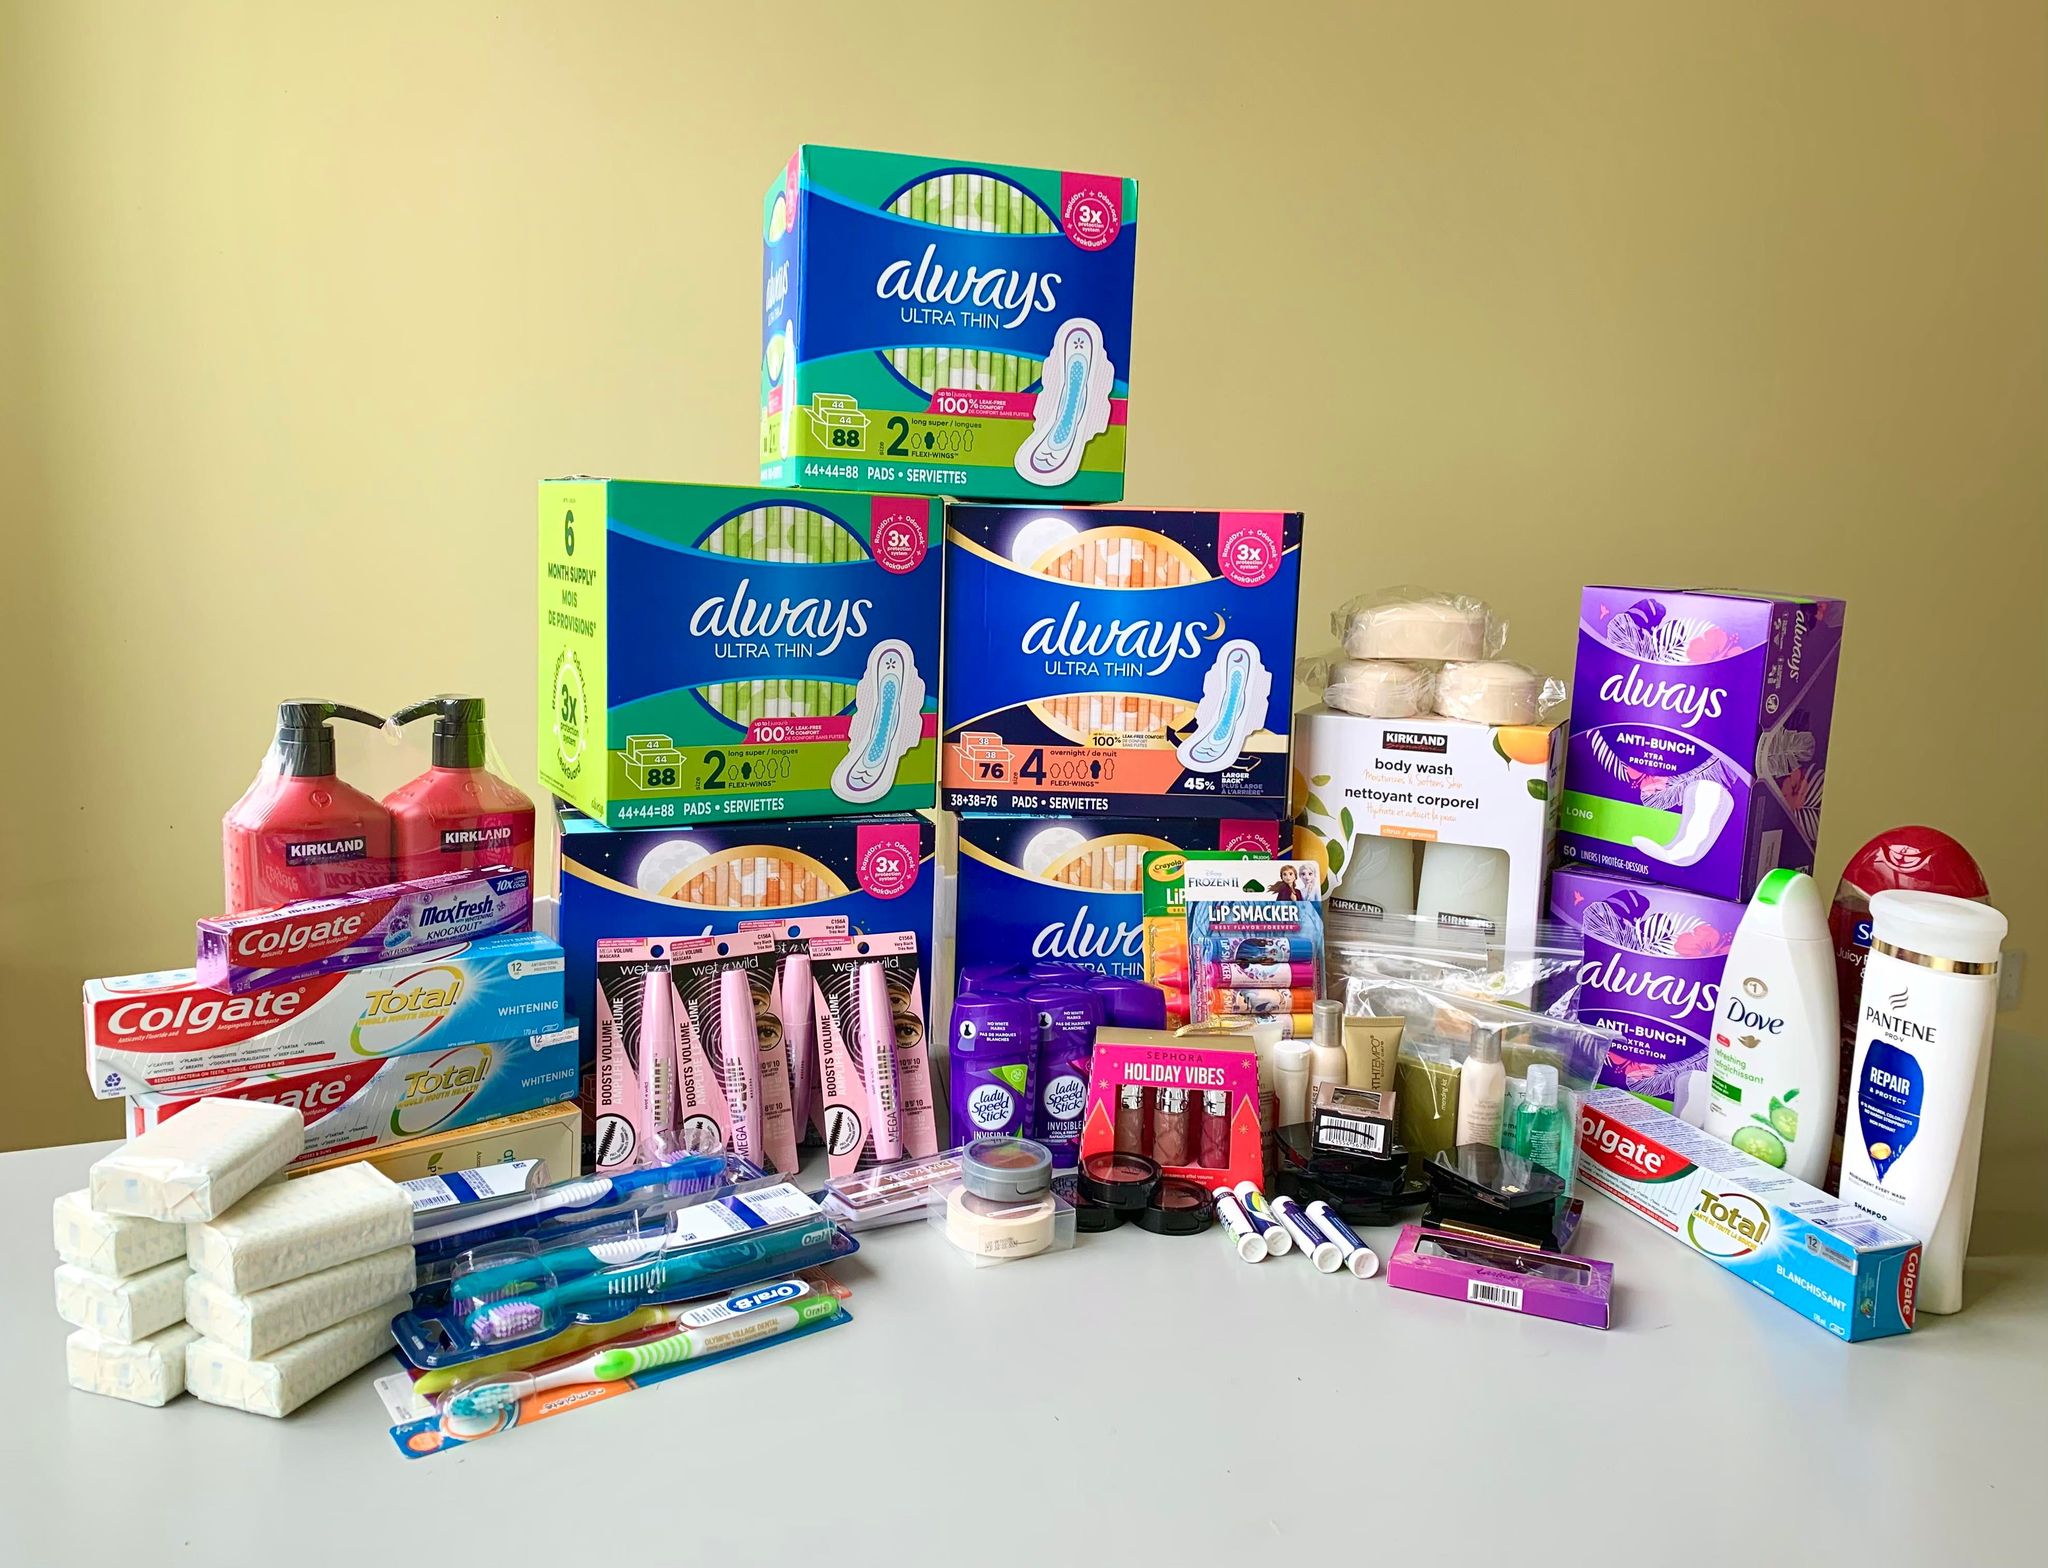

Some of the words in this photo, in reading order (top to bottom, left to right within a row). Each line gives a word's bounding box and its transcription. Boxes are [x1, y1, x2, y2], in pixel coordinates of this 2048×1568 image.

[1079, 205, 1102, 223] 3x
[876, 243, 1062, 329] always
[901, 307, 955, 326] ULTRA
[961, 311, 999, 329] THIN
[832, 401, 844, 409] 44
[911, 418, 927, 426] long
[928, 420, 949, 428] super
[954, 421, 982, 429] longues
[833, 429, 860, 447] 88
[887, 416, 909, 456] 2
[804, 463, 859, 479] 44+44=88
[867, 467, 894, 481] PADS
[907, 469, 967, 484] SERVIETTES
[565, 509, 574, 557] 6
[875, 516, 893, 544] RapidDry
[906, 516, 925, 544] OdorLock
[888, 530, 910, 547] 3x
[1222, 531, 1243, 558] RapidDry
[1257, 530, 1278, 558] OdorLock
[1237, 544, 1261, 560] 3x
[548, 562, 570, 581] MONTH
[882, 558, 915, 570] LeakGuard
[562, 589, 578, 608] MOIS
[548, 609, 556, 627] DE
[690, 578, 873, 656] always
[1021, 600, 1207, 676] always
[1788, 610, 1807, 680] always
[715, 643, 770, 659] ULTRA
[775, 643, 813, 658] THIN
[1045, 661, 1099, 677] ULTRA
[1104, 663, 1143, 678] THIN
[562, 684, 577, 726] 3x
[1600, 664, 1728, 728] always
[647, 741, 659, 749] 44
[1093, 735, 1121, 746] 100%
[1386, 732, 1446, 747] KIRKLAND
[1616, 732, 1696, 756] ANTI-BUNCH
[728, 750, 745, 759] long
[746, 749, 766, 758] super
[771, 748, 798, 757] longues
[1050, 750, 1086, 758] overnight
[1643, 752, 1664, 761] XTRA
[703, 750, 726, 790] 2
[979, 762, 1004, 779] 76
[1019, 749, 1047, 785] 4
[1375, 757, 1412, 774] body
[1416, 763, 1453, 776] wash
[1629, 757, 1677, 771] PROTECTION
[648, 768, 675, 786] 88
[1184, 777, 1215, 790] 45%
[950, 794, 998, 807] 38+38=76
[1012, 795, 1038, 808] PADS
[1049, 797, 1108, 810] SERVIETTES
[1345, 786, 1413, 807] nettoyant
[1417, 793, 1479, 810] corporel
[618, 804, 674, 820] 44+44=88
[683, 801, 711, 816] PADS
[723, 798, 784, 814] SERVIETTES
[1566, 807, 1594, 820] LONG
[445, 828, 511, 844] KIRKLAND
[291, 839, 364, 857] KIRKLAND
[861, 844, 881, 871] RapidDry
[894, 841, 915, 869] OdorLock
[876, 857, 899, 873] 3x
[1154, 860, 1184, 871] Crayola
[1563, 845, 1577, 857] 50
[1581, 850, 1598, 863] LINERS
[1601, 853, 1649, 875] PROTÈGE-DESSOUS
[870, 884, 904, 895] LeakGuard
[1188, 878, 1230, 888] FROZEN
[1231, 878, 1239, 888] II
[419, 895, 494, 927] MaxFresh
[1234, 905, 1299, 922] SMACKER
[1331, 898, 1382, 914] KIRKLAND
[1032, 905, 1144, 958] alwa
[685, 948, 703, 956] VOLUME
[1837, 947, 1862, 966] Juicy
[510, 962, 522, 972] 12
[620, 963, 649, 976] wet
[692, 963, 718, 977] wet
[732, 955, 759, 969] wild
[832, 961, 859, 972] wet
[1576, 952, 1720, 1020] always
[365, 981, 460, 1016] Total
[498, 1000, 559, 1017] WHITENING
[1727, 996, 1785, 1035] Dove
[1596, 1017, 1687, 1046] ANTI-BUNCH
[1866, 1006, 1937, 1044] PANTENE
[602, 1019, 612, 1061] VOLUME
[680, 1021, 692, 1064] VOLUME
[821, 1014, 832, 1056] VOLUME
[1627, 1038, 1651, 1049] XTRA
[1885, 1031, 1905, 1042] PRO-V
[1147, 1051, 1203, 1063] SEPHORA
[1611, 1042, 1667, 1060] PROTECTION
[404, 1057, 484, 1097] Total
[521, 1068, 575, 1088] WHITENING
[824, 1057, 837, 1097] BOOSTS
[1124, 1062, 1181, 1082] HOLIDAY
[1185, 1066, 1225, 1086] VIBES
[1870, 1066, 1911, 1096] REPAIR
[602, 1065, 612, 1106] BOOSTS
[683, 1066, 696, 1107] BOOSTS
[1055, 1079, 1079, 1094] lady
[980, 1089, 1005, 1104] lady
[1047, 1086, 1084, 1107] Speed
[1875, 1089, 1907, 1106] PROTECT
[972, 1097, 1009, 1116] Speed
[1053, 1101, 1082, 1114] Stick
[978, 1110, 1009, 1124] Stick
[1048, 1121, 1082, 1131] INVISIBLE
[886, 1111, 899, 1143] MEGA
[1700, 1188, 1768, 1243] Total
[1854, 1201, 1887, 1221] SHAMPOO
[1807, 1235, 1818, 1249] 12
[1776, 1263, 1847, 1312] BLANCHISSANT
[1903, 1252, 1919, 1315] Colgate
[734, 1286, 794, 1310] Oral-B
[704, 1331, 732, 1346] OLYMPIC
[732, 1325, 757, 1339] VILLAGE
[757, 1318, 780, 1331] DENTAL
